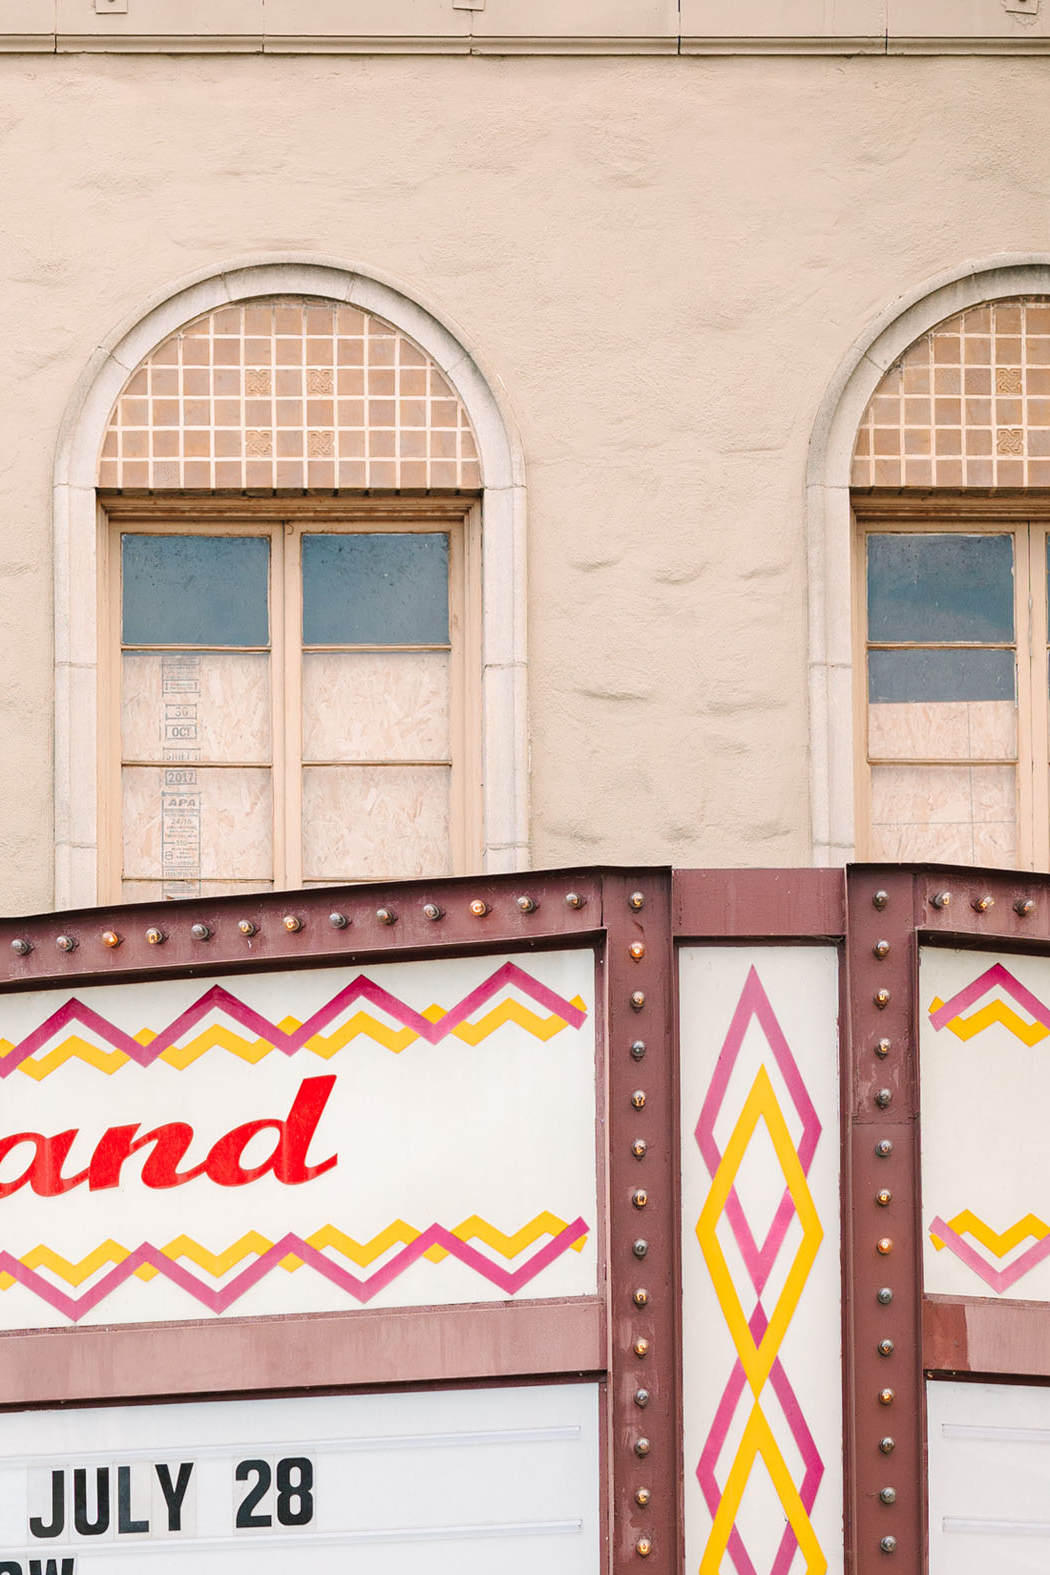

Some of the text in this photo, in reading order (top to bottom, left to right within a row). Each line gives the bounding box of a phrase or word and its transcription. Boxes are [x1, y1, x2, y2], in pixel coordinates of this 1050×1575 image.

[171, 727, 191, 737] OCT
[168, 772, 193, 783] 2017
[29, 1462, 194, 1539] JULY
[235, 1457, 314, 1529] 28
